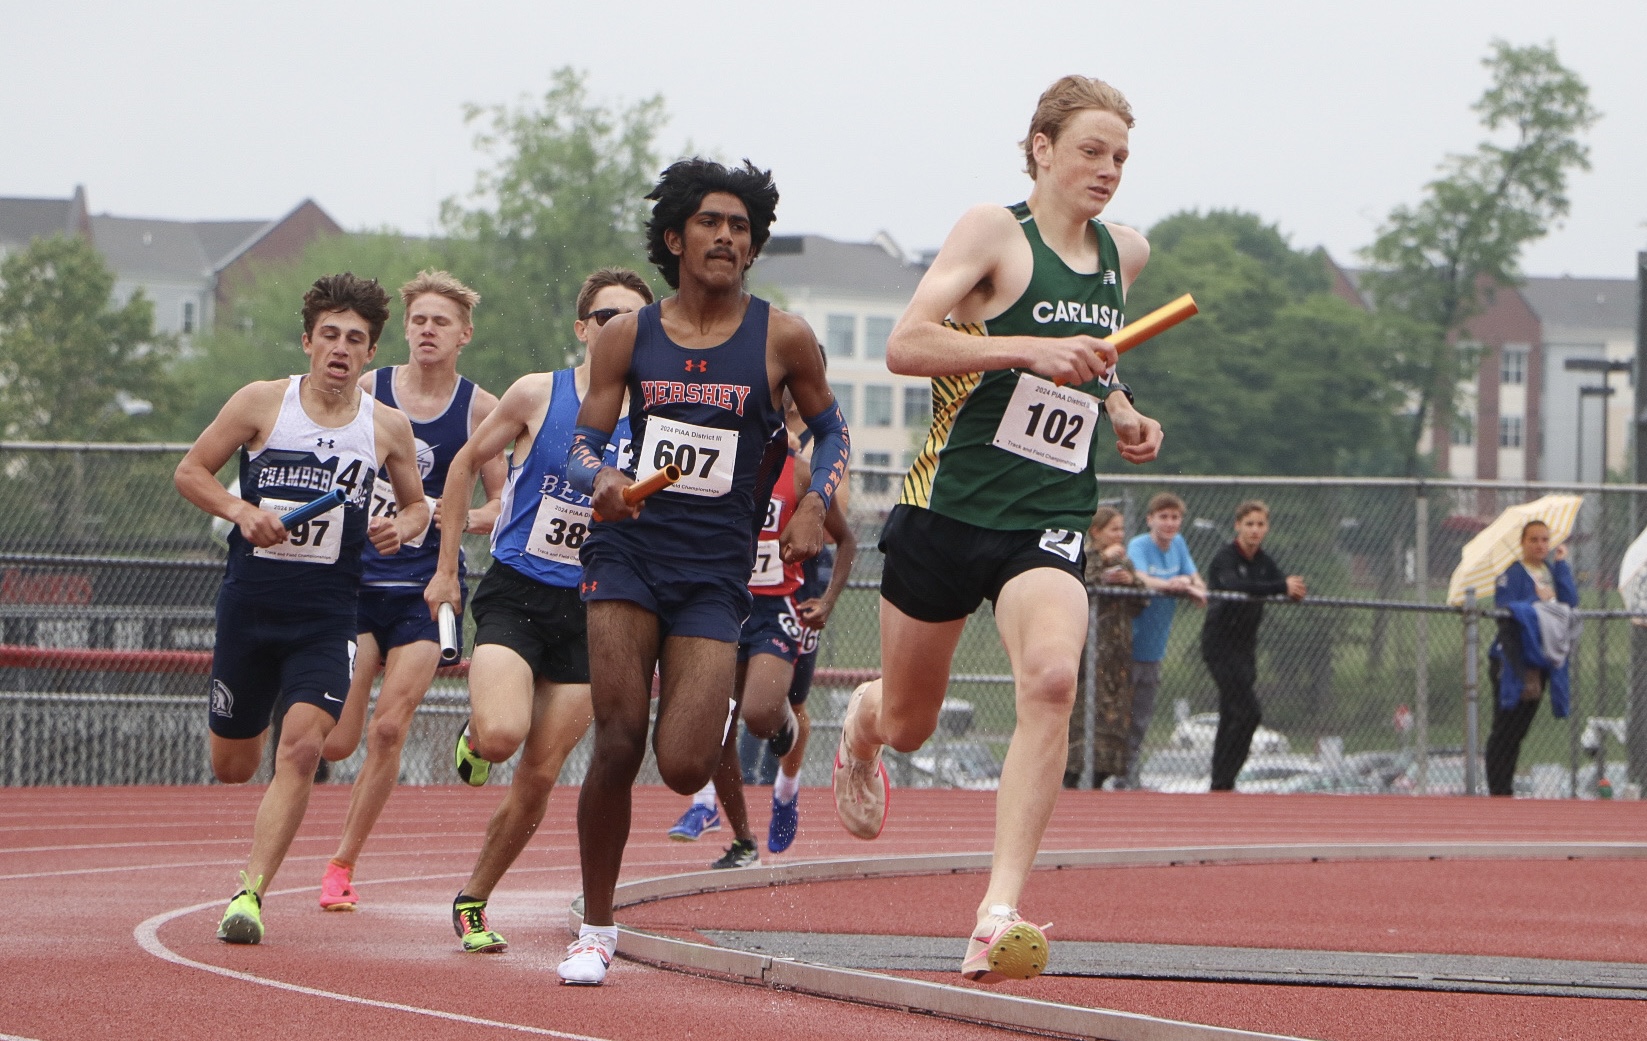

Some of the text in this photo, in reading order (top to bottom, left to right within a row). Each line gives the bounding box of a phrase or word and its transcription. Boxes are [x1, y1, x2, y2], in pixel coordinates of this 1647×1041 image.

[640, 380, 751, 417] HERSHEY
[1035, 386, 1051, 396] 2024
[1051, 391, 1066, 401] PIAA
[660, 425, 674, 433] 2024
[675, 428, 690, 436] PIAA
[691, 432, 715, 440] District
[1025, 402, 1084, 450] 102
[653, 439, 720, 479] 607
[336, 459, 362, 495] 4
[371, 494, 398, 519] 78
[555, 505, 568, 514] 2024
[569, 509, 584, 517] PIAA
[281, 520, 330, 547] 97
[545, 517, 587, 549] 38
[752, 554, 771, 573] 7
